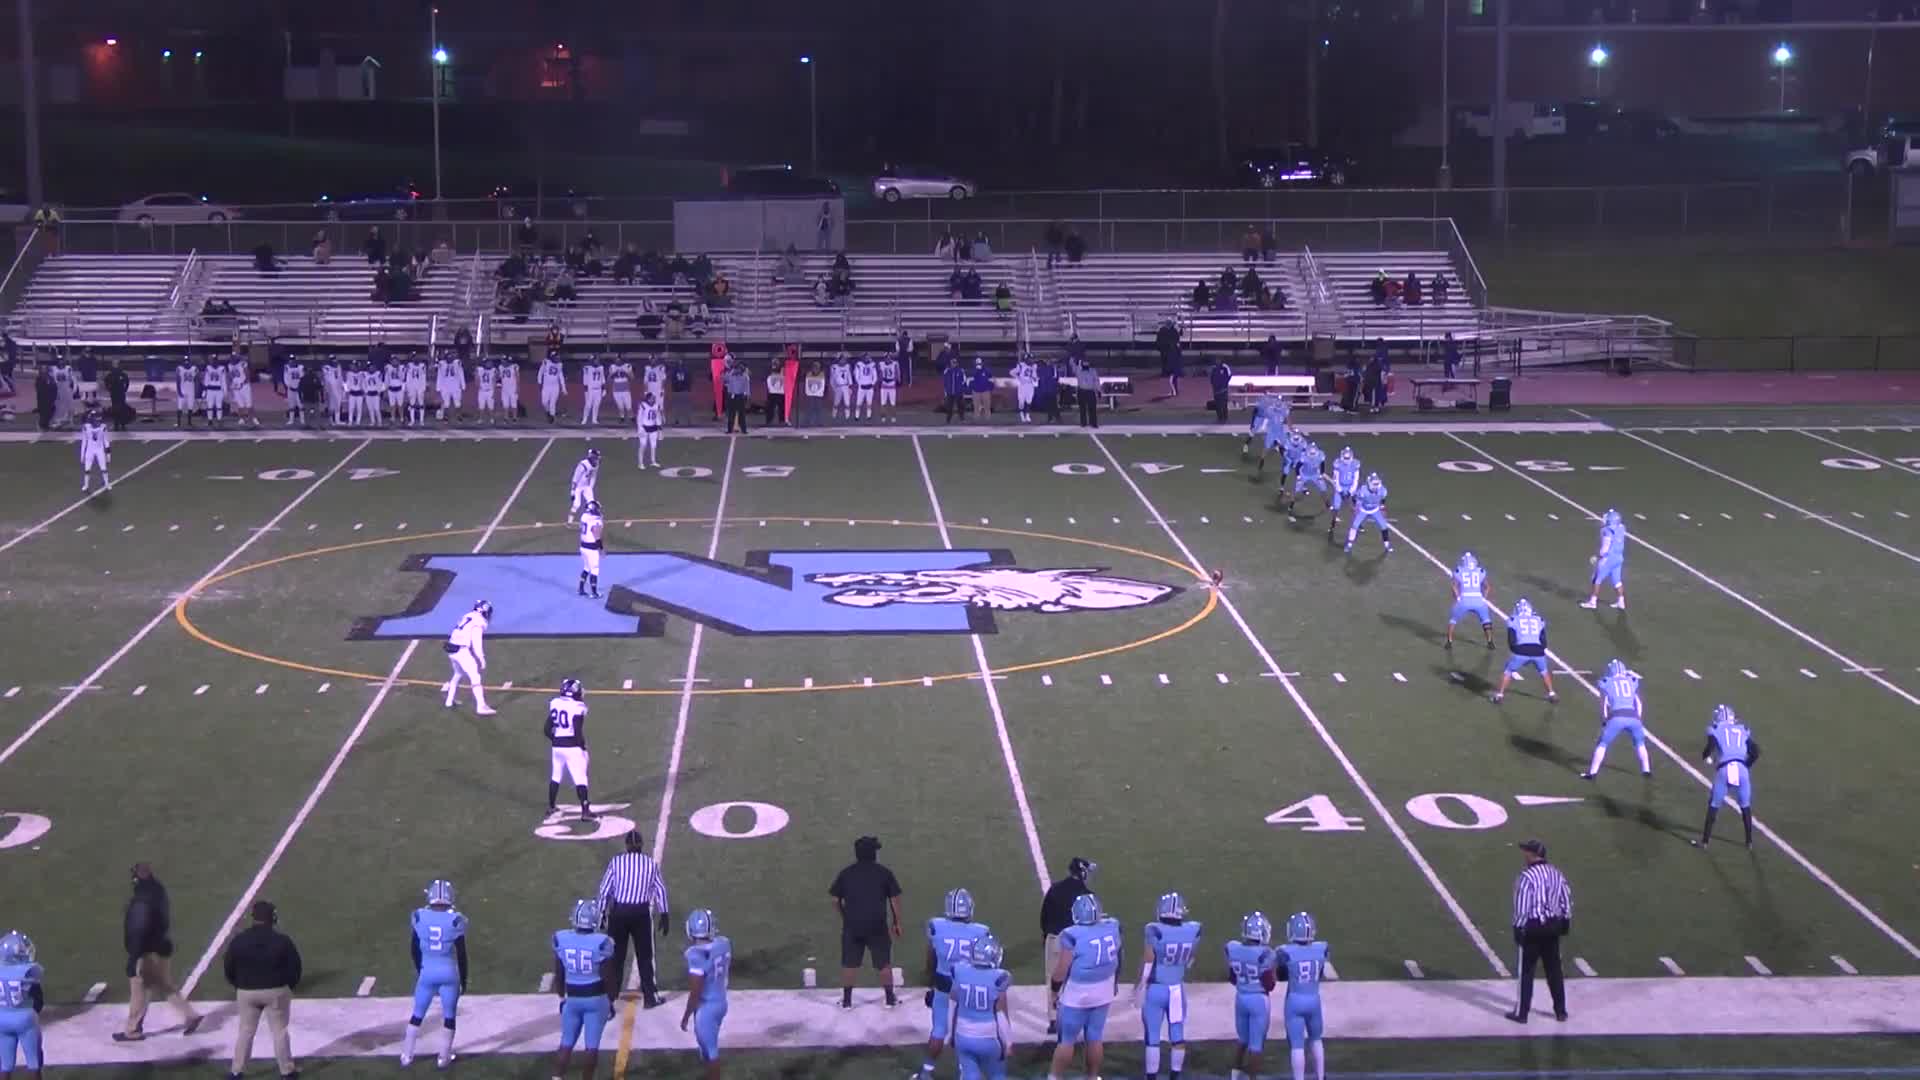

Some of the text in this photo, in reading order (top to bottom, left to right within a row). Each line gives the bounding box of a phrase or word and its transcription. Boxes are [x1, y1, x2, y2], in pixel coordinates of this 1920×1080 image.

[1461, 572, 1480, 587] 50
[1519, 618, 1539, 635] 53
[1614, 678, 1632, 698] 10
[551, 708, 569, 729] 20
[1724, 727, 1742, 747] 17
[429, 926, 443, 950] 3
[943, 938, 971, 961] 75
[1089, 935, 1116, 965] 72
[564, 949, 593, 975] 56
[1298, 960, 1320, 983] 81
[960, 983, 988, 1010] 70
